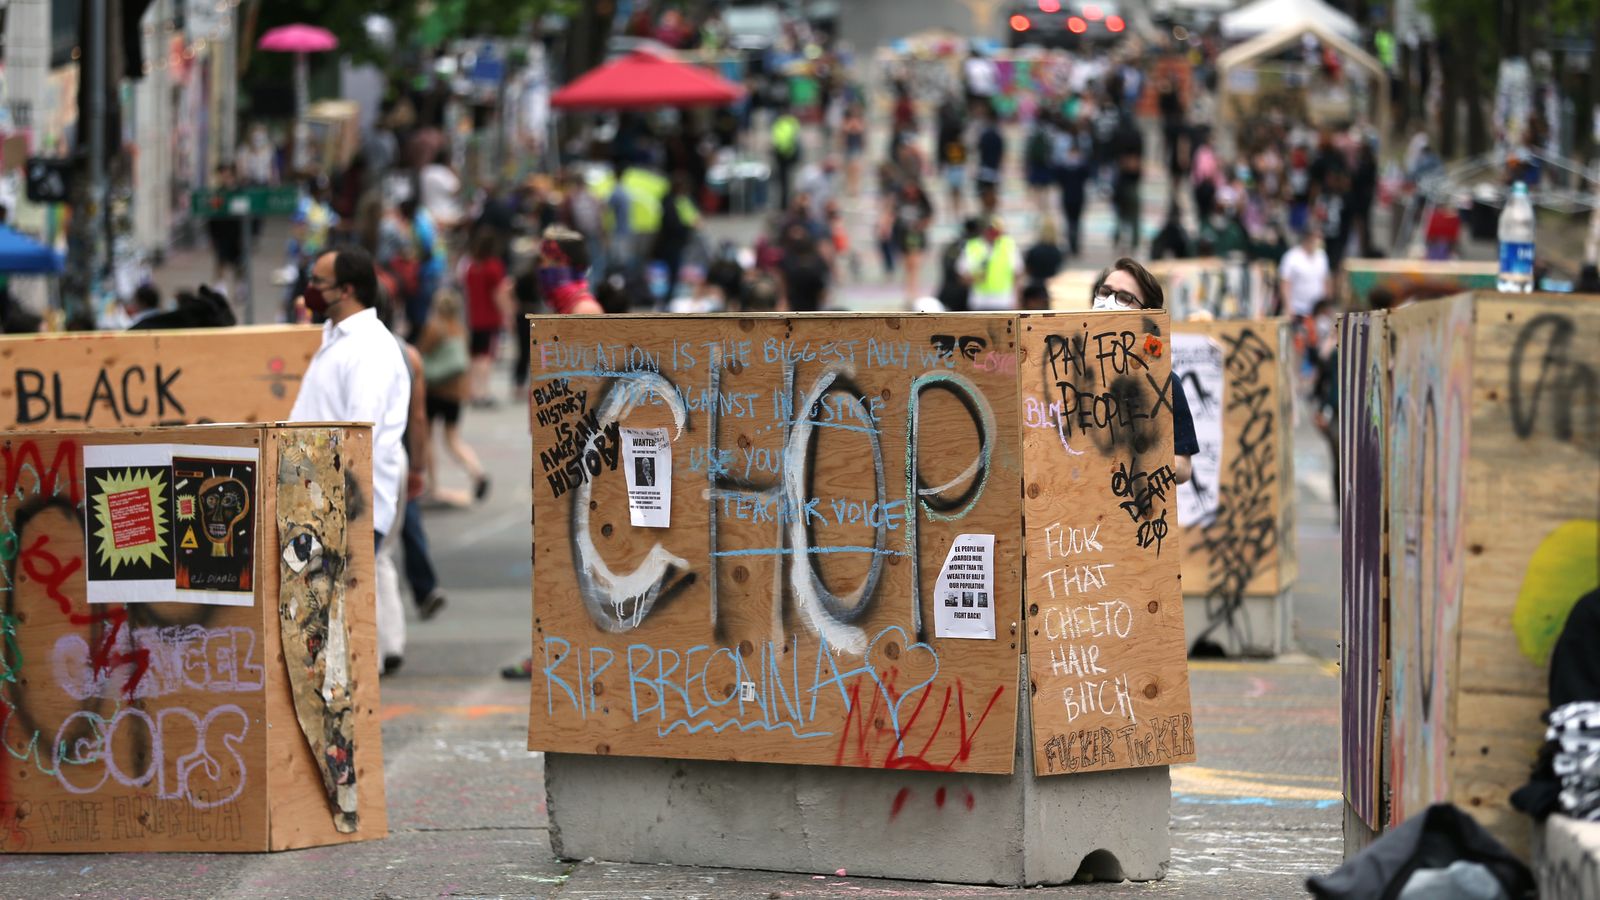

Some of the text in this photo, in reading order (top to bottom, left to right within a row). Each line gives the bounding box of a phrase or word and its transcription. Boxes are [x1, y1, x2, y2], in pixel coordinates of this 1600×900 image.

[539, 337, 661, 372] EDUCATION
[672, 339, 696, 371] IS
[700, 339, 752, 370] THE
[763, 337, 860, 364] BIGGEST
[867, 338, 909, 369] ALLY
[1044, 331, 1149, 387] PAY FOR
[15, 364, 187, 424] BLACK
[533, 378, 573, 406] BLACK
[536, 390, 587, 427] HISTORY
[674, 384, 759, 418] AGAINST
[774, 386, 886, 421] INUSTICE
[1056, 381, 1149, 445] PEOPLE
[555, 422, 574, 442] IS
[547, 421, 619, 498] HISTORY
[743, 447, 791, 479] YOU
[831, 496, 906, 530] VOICE
[1045, 523, 1103, 559] FUCK
[1041, 563, 1114, 598] THAT
[1045, 600, 1133, 640] CHEETO
[543, 635, 614, 721] RIP
[626, 624, 874, 729] BREONNA
[1050, 644, 1107, 677] HAIR
[1062, 673, 1137, 726] BITCH
[53, 703, 249, 809] COPS
[1042, 711, 1194, 774] FUCKER TUCKER
